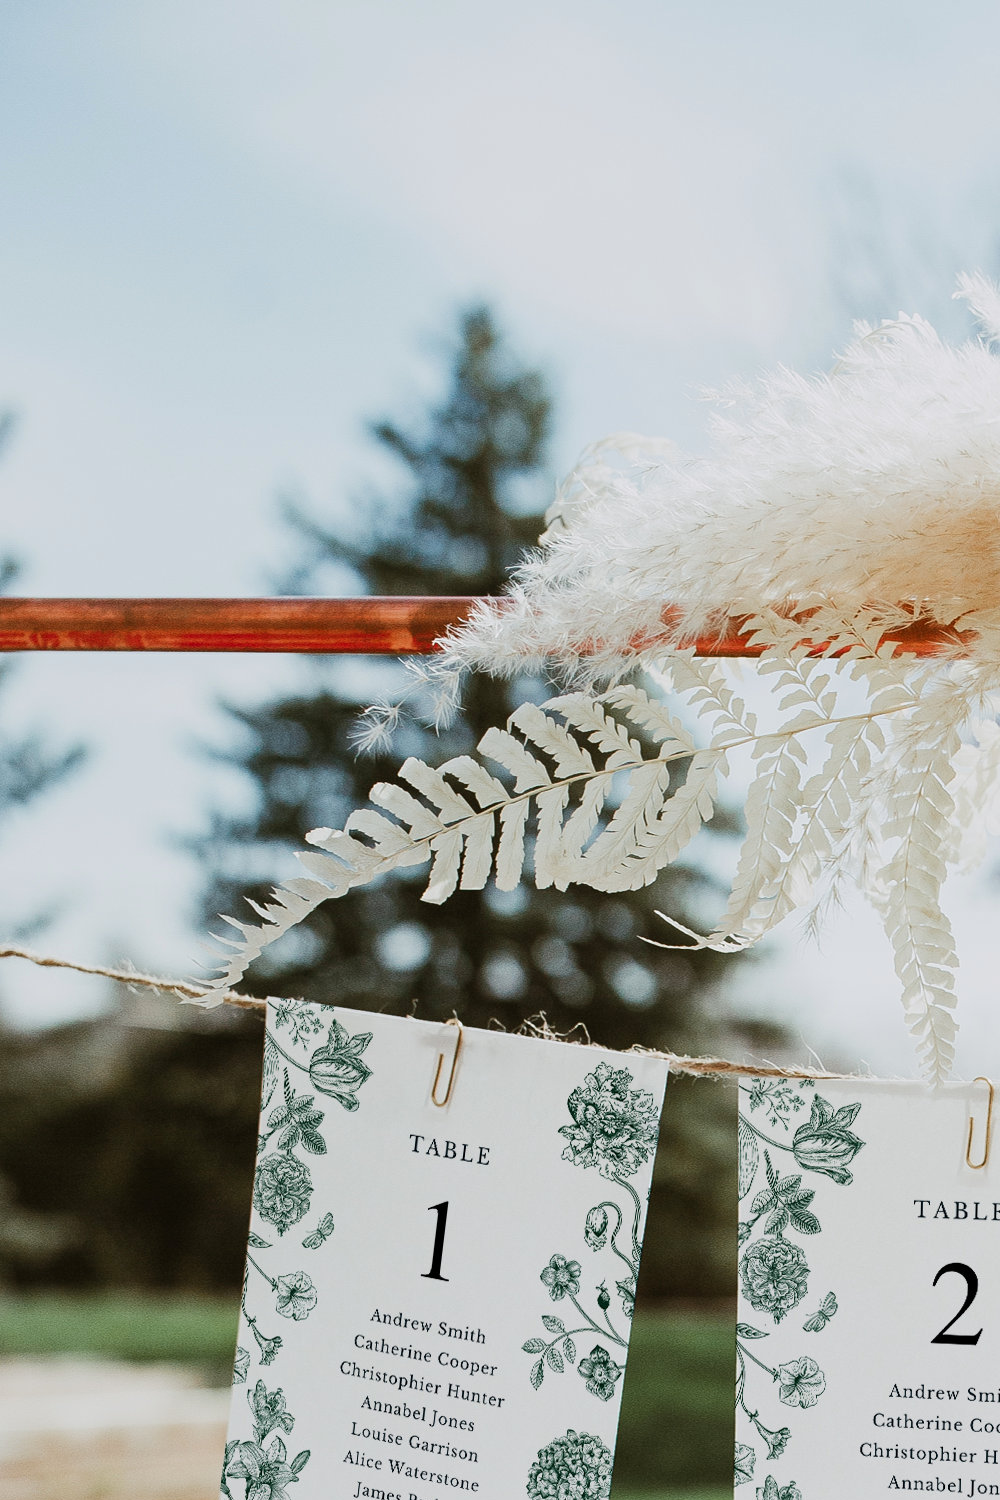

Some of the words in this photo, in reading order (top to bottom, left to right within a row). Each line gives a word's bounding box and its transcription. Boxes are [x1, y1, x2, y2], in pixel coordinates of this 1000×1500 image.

[409, 1133, 491, 1166] TABLE
[420, 1200, 450, 1283] 1
[929, 1261, 984, 1346] 2
[369, 1308, 433, 1333] Andrew
[437, 1321, 486, 1345] Smith
[353, 1333, 432, 1363] Catherine
[437, 1351, 498, 1377] Cooper
[339, 1360, 442, 1395] Christophier
[446, 1382, 506, 1408] Hunter
[888, 1383, 960, 1401] Andrew
[360, 1395, 427, 1422] Annabel
[428, 1409, 475, 1432] Jones
[872, 1412, 963, 1432] Catherine
[350, 1421, 403, 1446] Louise
[408, 1434, 479, 1464] Garrison
[859, 1442, 977, 1465] Christophier
[342, 1449, 383, 1471] Alice
[388, 1458, 480, 1493] Waterstone
[887, 1474, 963, 1494] Annabel
